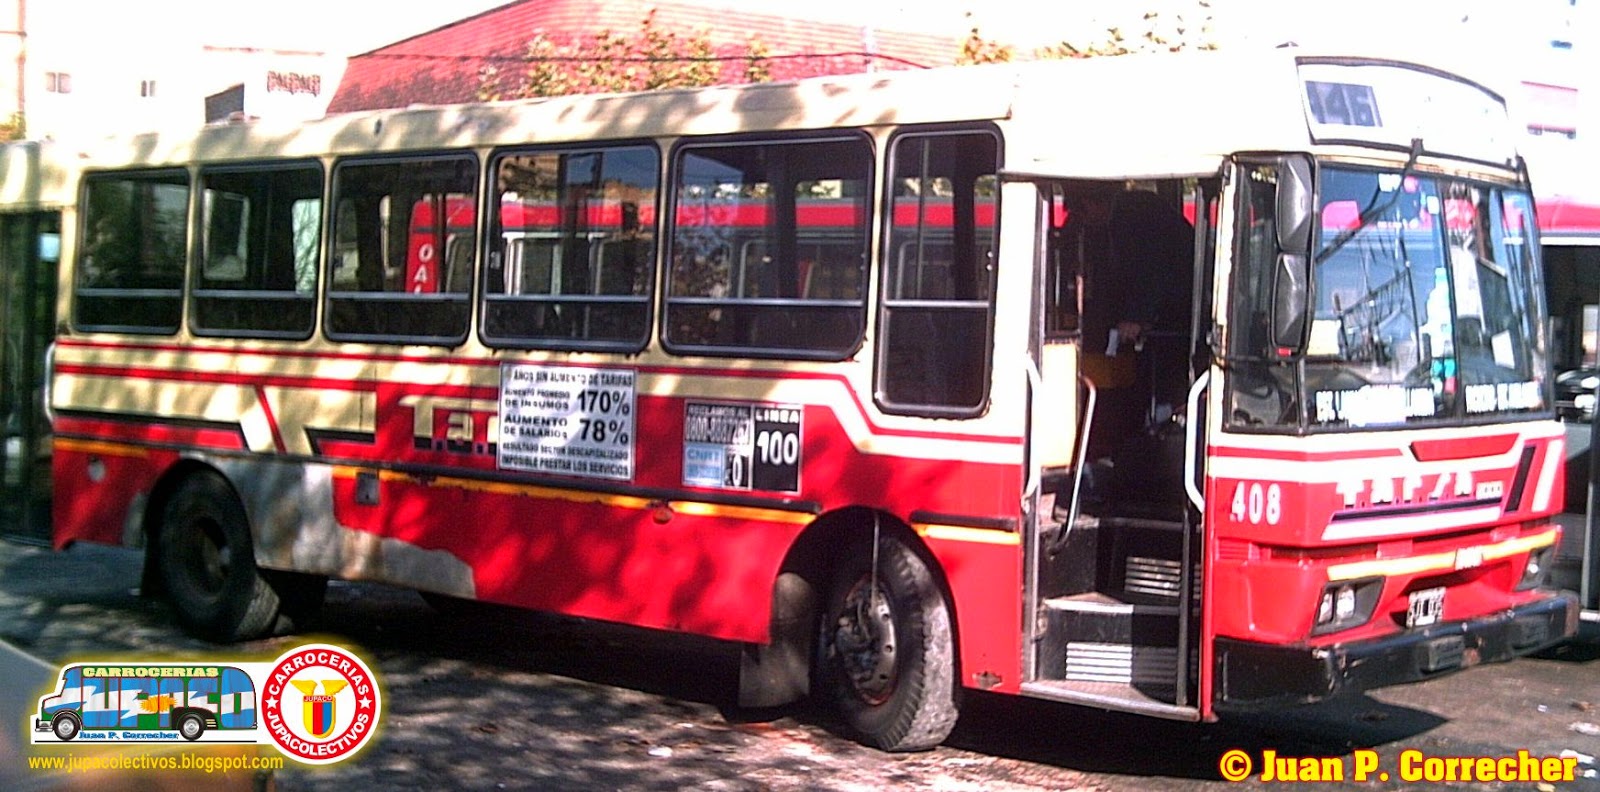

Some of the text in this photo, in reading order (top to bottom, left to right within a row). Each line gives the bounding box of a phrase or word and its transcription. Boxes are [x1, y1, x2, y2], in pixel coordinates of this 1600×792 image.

[588, 374, 599, 386] DE
[601, 374, 632, 387] TARIFAS
[537, 390, 570, 399] PROMEDIO
[505, 399, 569, 411] DE INSUMOS
[577, 389, 630, 415] 170%
[504, 414, 567, 427] AUMENTO
[755, 409, 799, 423] LINEA
[504, 427, 567, 439] DE SALARIOS
[580, 418, 629, 446] 78%
[757, 430, 798, 465] 100
[540, 458, 571, 470] PRESTAR
[572, 461, 588, 472] LOS
[589, 461, 629, 476] SERVICIOS
[1231, 481, 1281, 524] 408
